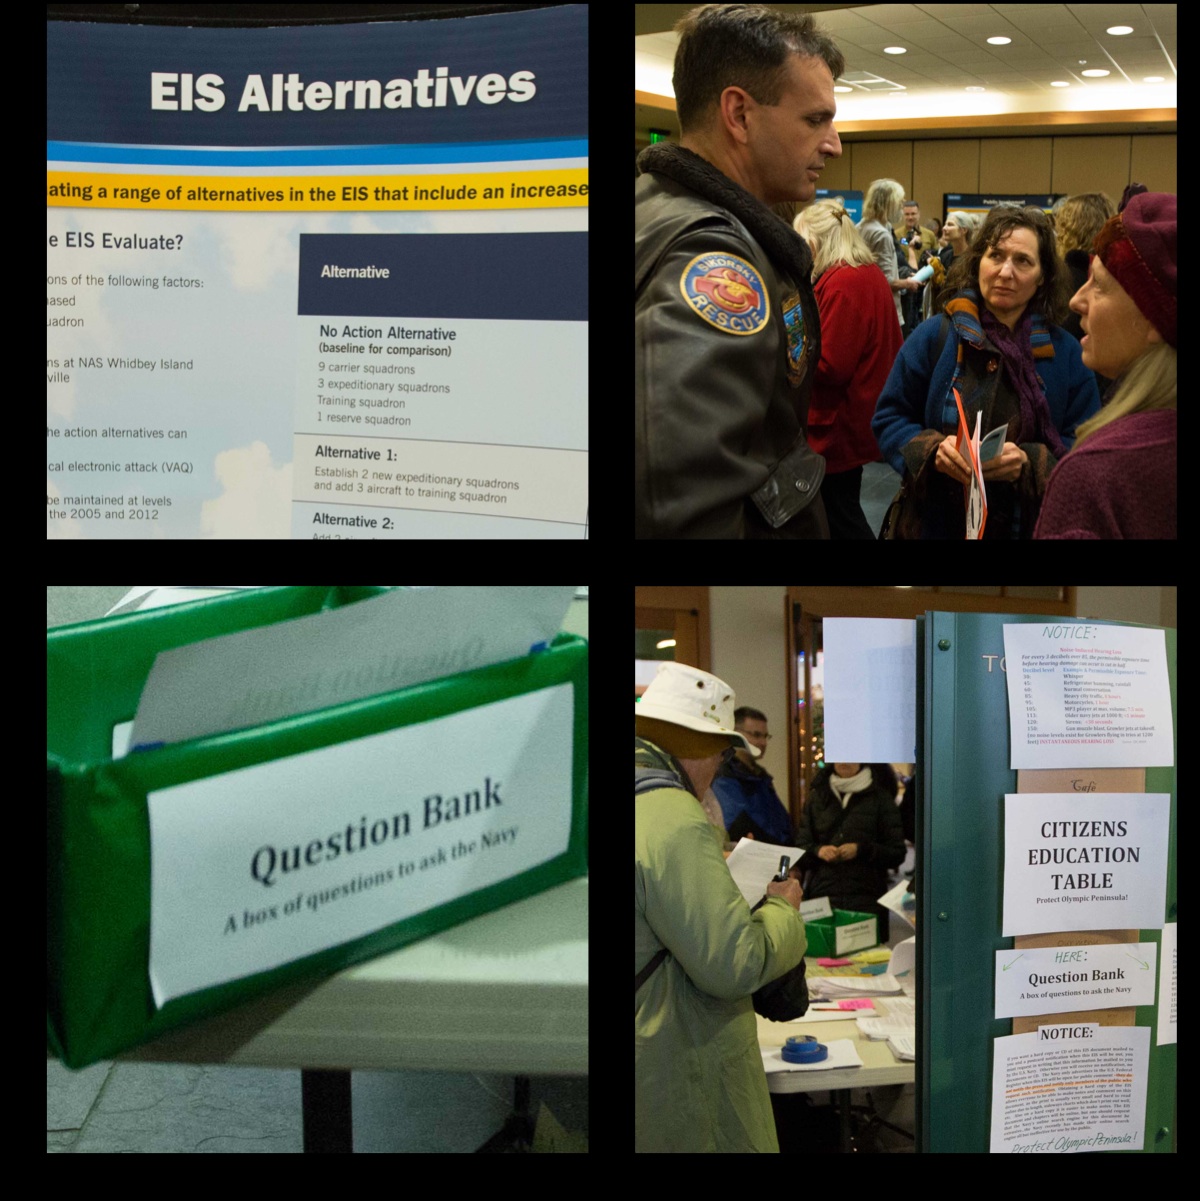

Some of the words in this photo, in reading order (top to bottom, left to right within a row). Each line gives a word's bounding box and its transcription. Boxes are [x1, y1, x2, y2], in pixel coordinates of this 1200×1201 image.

[151, 71, 225, 112] EIS
[238, 66, 537, 112] Alternatives
[98, 187, 107, 198] a
[113, 188, 160, 202] range
[166, 186, 182, 200] of
[187, 186, 284, 201] alternatives
[290, 188, 304, 200] in
[309, 188, 336, 200] the
[342, 187, 368, 200] EIS
[374, 186, 408, 200] that
[414, 186, 477, 200] include
[483, 187, 504, 199] an
[511, 184, 588, 198] increase
[66, 232, 94, 247] EIS
[102, 233, 183, 250] Evaluate?
[321, 265, 390, 278] Alternative
[698, 258, 757, 284] SIKORSKY
[72, 275, 82, 285] of
[86, 276, 104, 286] the
[108, 275, 159, 289] following
[163, 276, 203, 288] factors:
[690, 295, 764, 330] RESCUE
[320, 325, 337, 337] No
[342, 326, 382, 338] Action
[387, 327, 456, 340] Alternative
[319, 342, 365, 354] (baseline
[369, 344, 382, 354] for
[387, 346, 451, 357] comparison)
[64, 358, 74, 368] at
[79, 358, 103, 368] NAS
[108, 358, 156, 371] Whidbey
[161, 359, 193, 370] Island
[319, 362, 325, 371] 9
[329, 362, 360, 373] carrier
[364, 364, 415, 375] squadrons
[48, 373, 70, 382] ville
[318, 378, 324, 388] 3
[328, 380, 394, 393] expeditionary
[398, 383, 450, 393] squadrons
[318, 395, 356, 408] Training
[359, 398, 405, 408] squadron
[318, 412, 322, 421] 1
[327, 414, 361, 423] reserve
[365, 416, 411, 426] squadron
[64, 427, 97, 437] action
[102, 428, 164, 438] alternatives
[168, 430, 187, 438] can
[315, 445, 380, 460] Alternative
[386, 449, 397, 461] 1:
[68, 462, 121, 472] electronic
[125, 462, 157, 472] attack
[162, 463, 193, 473] (VAQ)
[315, 466, 358, 478] Establish
[362, 470, 368, 479] 2
[372, 472, 392, 480] new
[396, 473, 463, 487] expeditionary
[466, 477, 519, 490] squadrons
[314, 481, 332, 490] and
[336, 483, 353, 492] add
[357, 483, 363, 493] 3
[367, 484, 402, 495] aircraft
[405, 486, 414, 496] to
[418, 488, 456, 501] training
[459, 491, 507, 503] squadron
[63, 495, 123, 505] maintained
[128, 496, 138, 506] at
[142, 496, 171, 506] levels
[49, 510, 66, 519] the
[71, 509, 100, 519] 2005
[105, 510, 124, 519] and
[129, 510, 159, 519] 2012
[313, 513, 377, 528] Alternative
[382, 518, 394, 529] 2:
[1043, 626, 1097, 639] NOTICE:
[251, 811, 411, 888] Question
[423, 776, 503, 830] Bank
[1041, 821, 1128, 838] CITIZENS
[1028, 847, 1140, 865] EDUCATION
[224, 914, 237, 935] A
[243, 907, 279, 928] box
[284, 893, 303, 915] of
[307, 869, 393, 911] questions
[399, 862, 414, 878] to
[419, 847, 447, 871] ask
[451, 840, 477, 860] the
[481, 825, 519, 850] Navy
[1051, 873, 1113, 890] TABLE
[1037, 896, 1061, 904] Protect
[1062, 896, 1089, 904] Olympic
[1055, 950, 1087, 963] HERE:
[1029, 969, 1088, 986] Question
[1092, 968, 1125, 980] Bank
[1049, 990, 1081, 998] questions
[1041, 1027, 1093, 1040] NOTICE:
[1012, 1141, 1054, 1153] Protect
[1055, 1137, 1091, 1151] Olympic
[1092, 1131, 1137, 1146] Peninsula!
